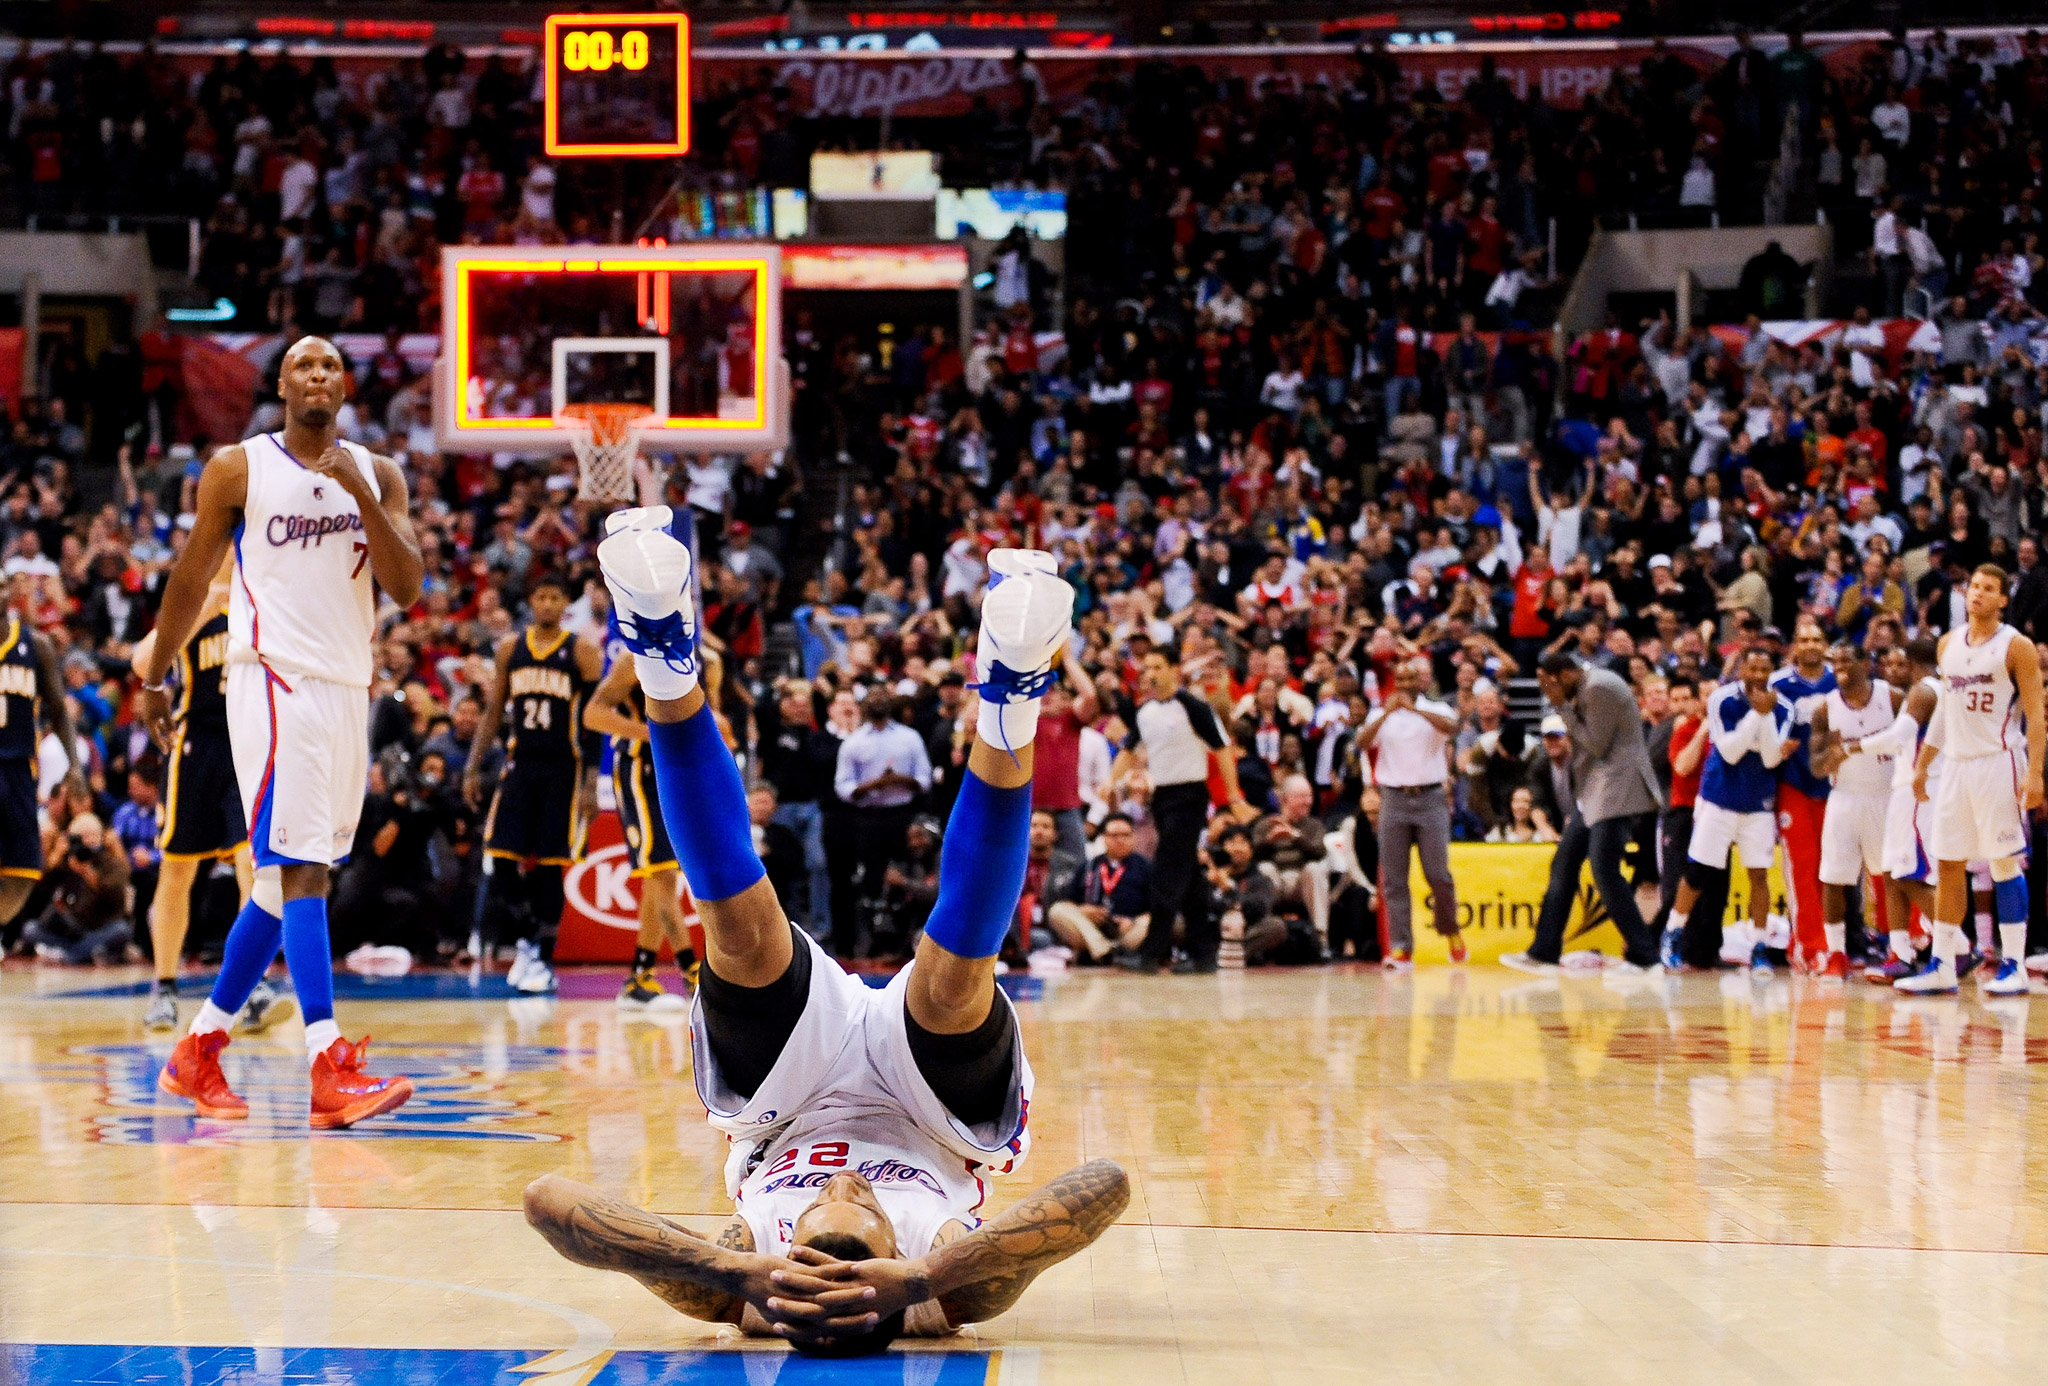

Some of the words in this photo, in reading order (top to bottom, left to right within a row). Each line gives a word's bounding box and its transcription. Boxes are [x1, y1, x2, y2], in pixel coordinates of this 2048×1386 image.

[563, 30, 649, 71] 00.0
[266, 512, 363, 549] Clipper
[350, 541, 369, 580] 7
[1965, 691, 1994, 713] 32
